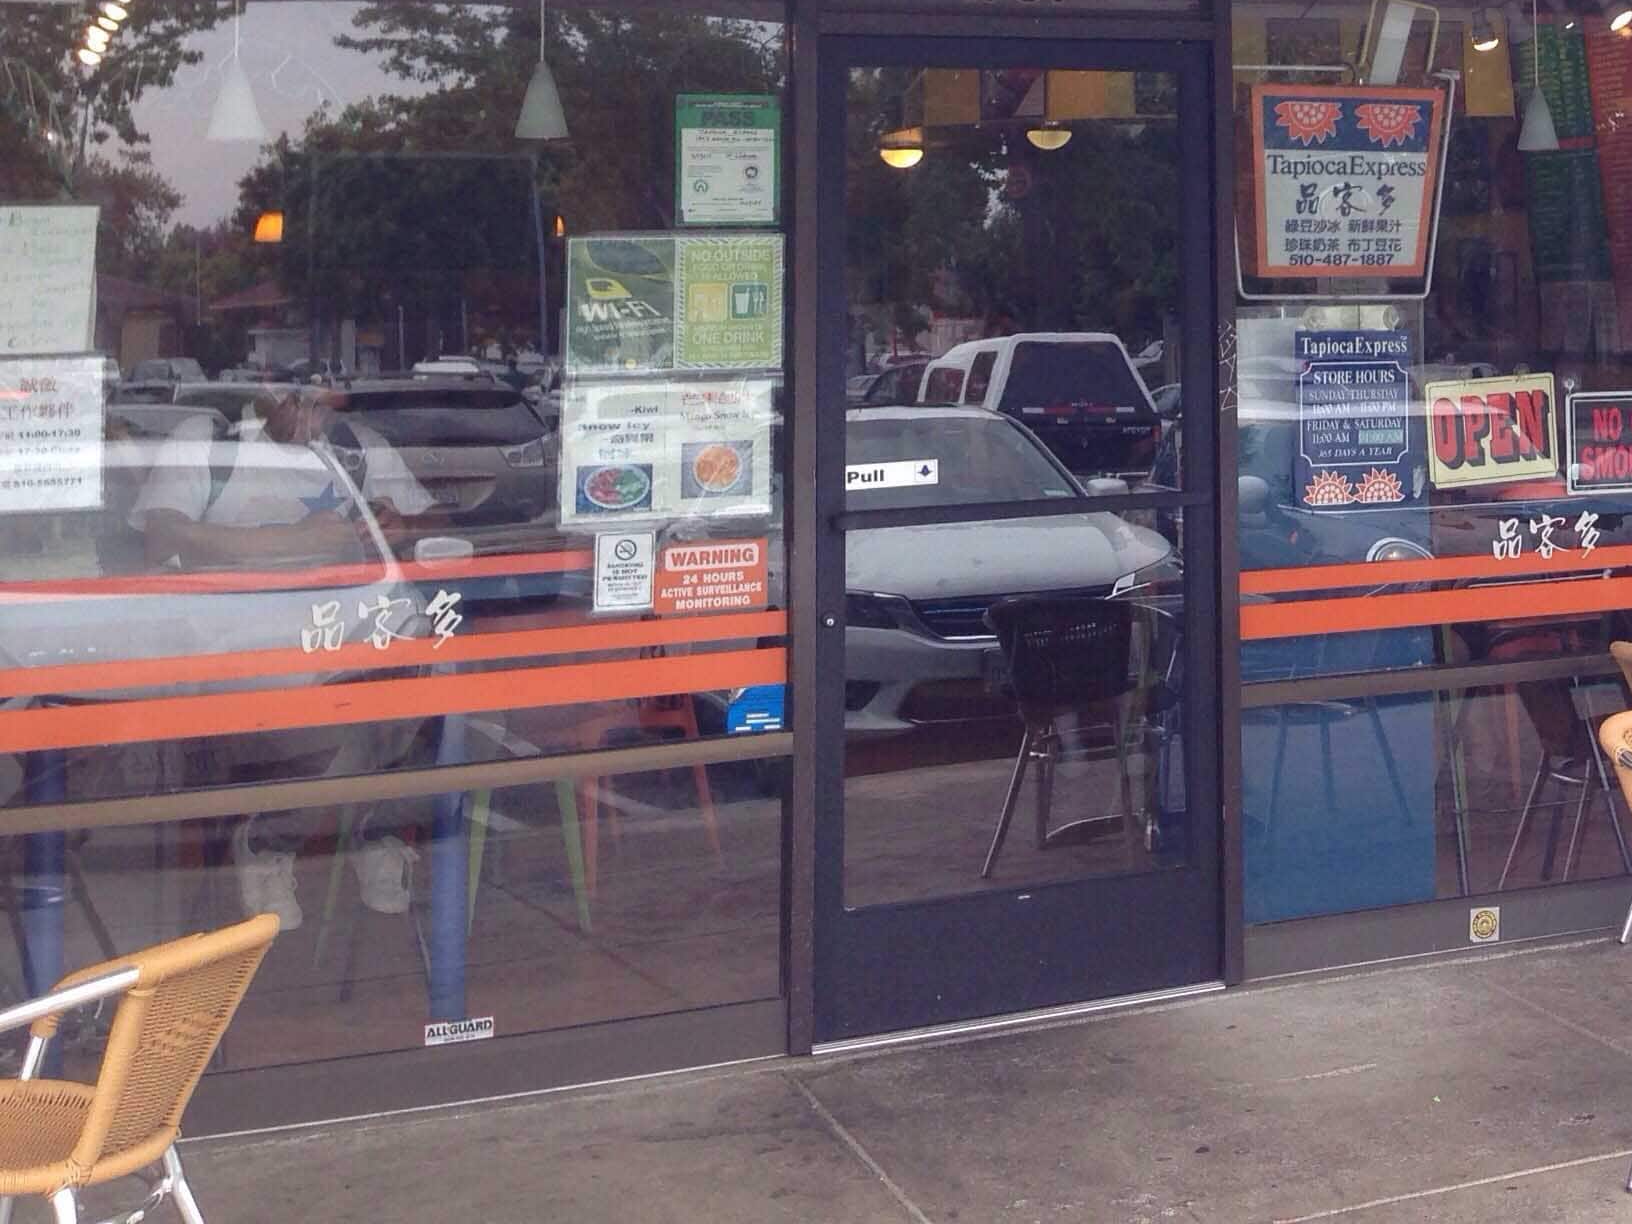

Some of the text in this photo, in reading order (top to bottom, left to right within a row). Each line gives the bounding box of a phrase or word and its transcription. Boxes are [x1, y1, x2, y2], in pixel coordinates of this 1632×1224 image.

[1267, 154, 1427, 181] TapiocaExpress
[1347, 219, 1402, 234] 新鮮果汁
[1284, 238, 1402, 253] 珍珠奶茶 布丁豆花
[691, 247, 771, 263] NO OUTSIDE
[1288, 254, 1394, 266] 510-487-1887
[692, 330, 765, 345] ONE DRINK
[1301, 336, 1408, 358] TapiocaExpress
[1313, 369, 1396, 385] STORE HOURS
[1309, 390, 1345, 401] SUNDAY
[1306, 421, 1341, 432] FRIDAY
[1353, 418, 1403, 429] SATURDAY
[1432, 389, 1552, 470] OPEN
[1591, 406, 1623, 441] NO
[1335, 432, 1350, 443] AM
[1369, 446, 1393, 456] YEAR
[847, 468, 885, 484] Pull
[670, 548, 755, 567] WARNING
[683, 571, 745, 585] 24 HOURS
[661, 582, 763, 598] ACTIVE SURVEILLANCE
[675, 595, 752, 611] MONITORING
